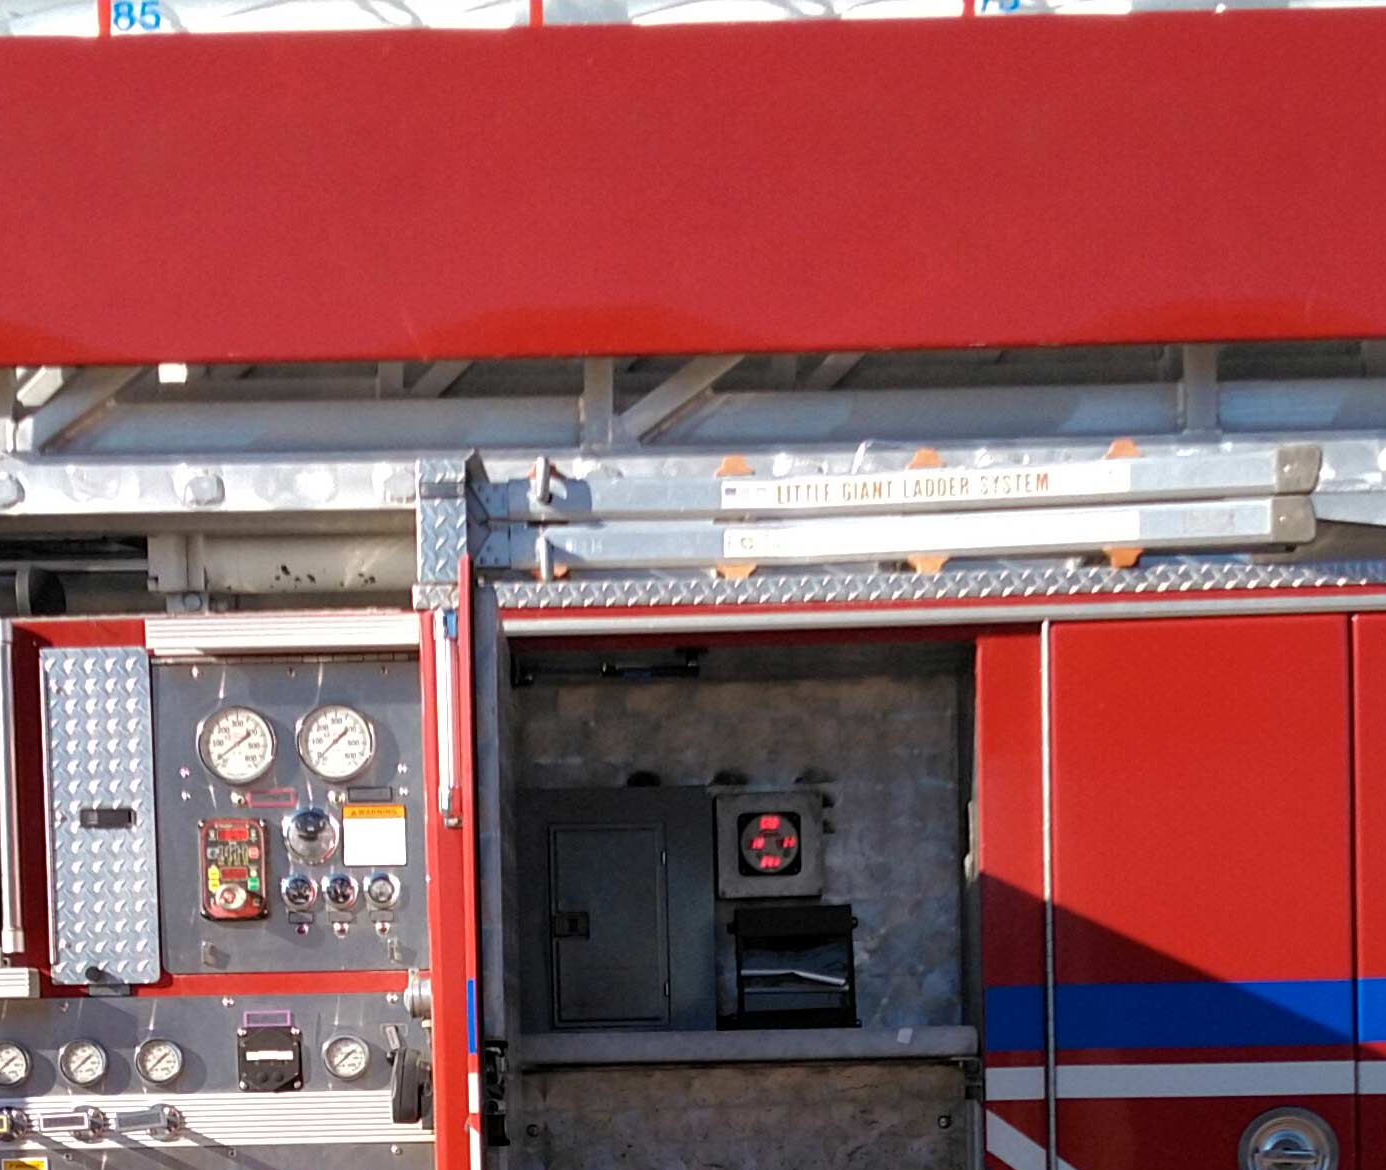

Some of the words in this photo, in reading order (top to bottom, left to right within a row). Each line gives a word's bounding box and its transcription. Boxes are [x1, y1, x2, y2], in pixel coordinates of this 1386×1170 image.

[113, 1, 161, 31] 85
[777, 483, 830, 504] LITTLE
[842, 480, 893, 500] GIANT
[903, 477, 969, 499] LADDER
[980, 472, 1050, 496] SYSTEM
